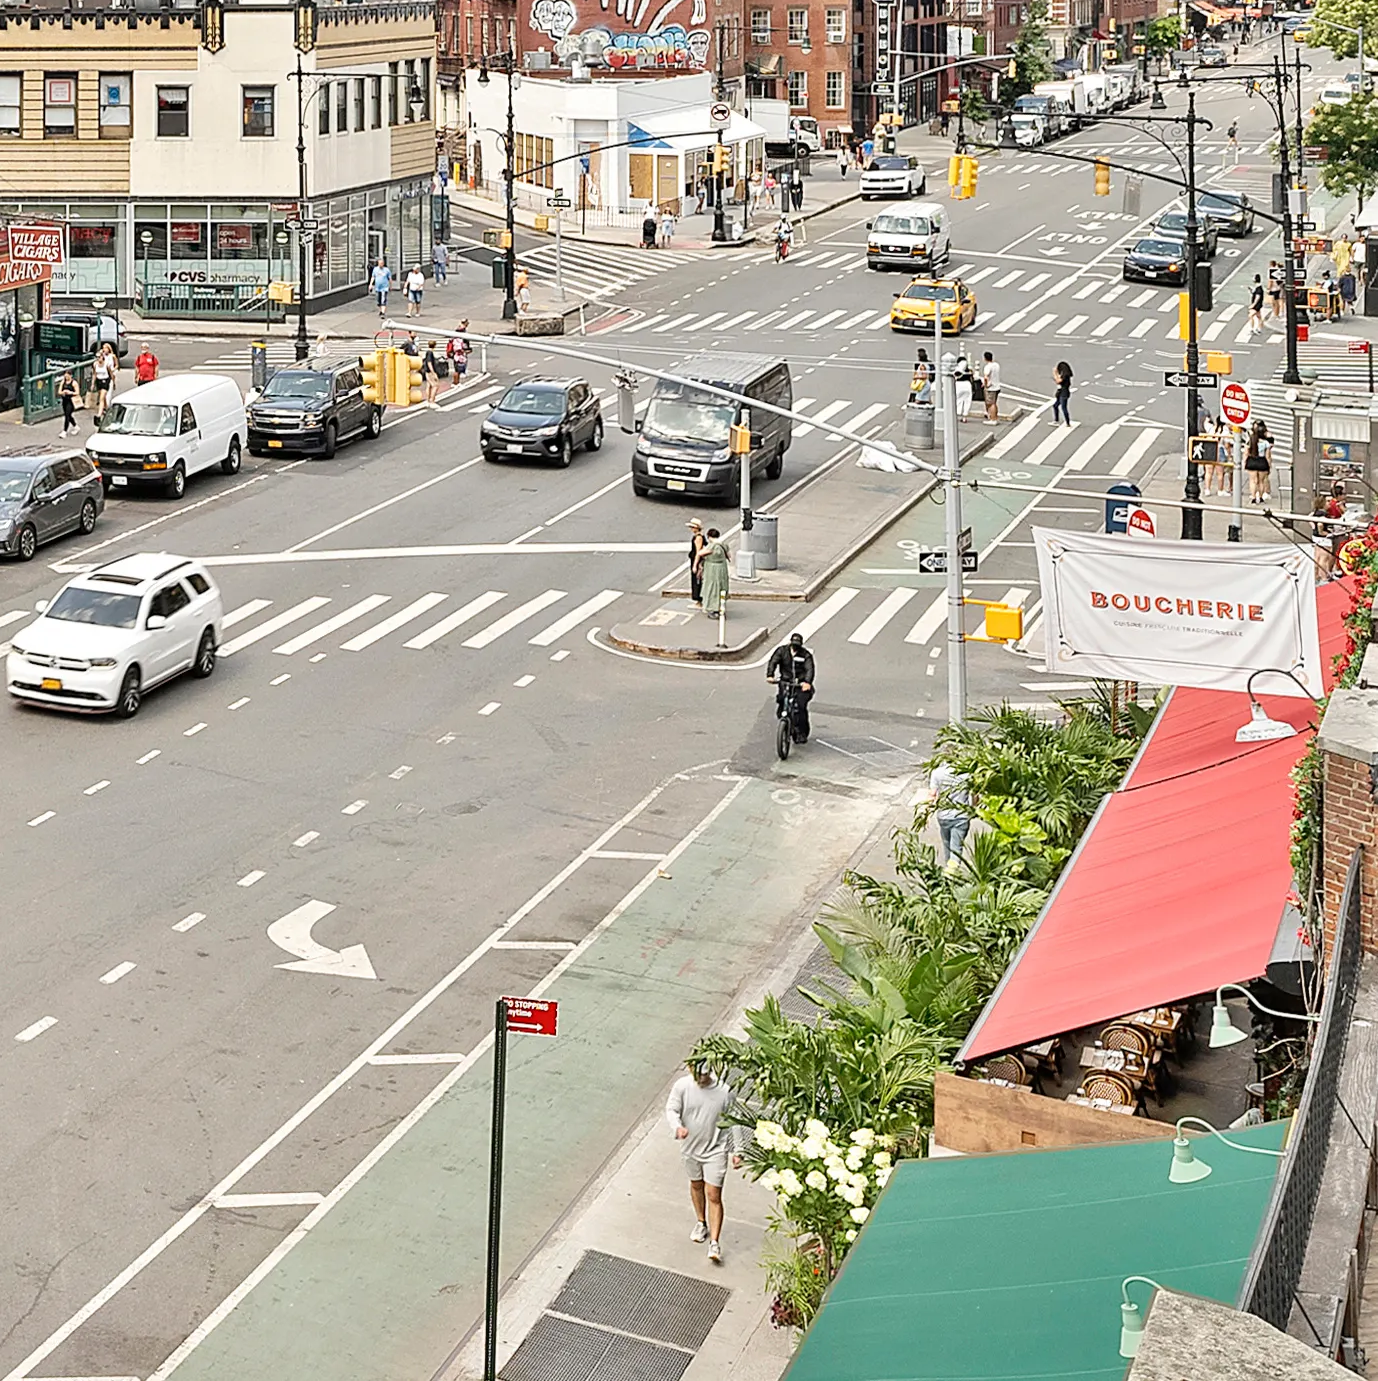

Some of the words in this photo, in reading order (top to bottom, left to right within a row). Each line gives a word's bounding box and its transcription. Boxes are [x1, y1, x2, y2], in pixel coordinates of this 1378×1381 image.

[1073, 211, 1140, 221] ONLY
[12, 233, 60, 246] VILLAGE
[1037, 232, 1109, 245] ONLY
[14, 246, 60, 261] CIGARS
[178, 271, 207, 283] CVS
[1226, 389, 1234, 397] DO
[1235, 392, 1246, 400] NOT
[1227, 408, 1244, 418] ENTER
[1131, 516, 1140, 526] DO
[1140, 519, 1151, 531] NOT
[962, 558, 975, 567] AY
[1090, 591, 1265, 622] BOUCHERIE
[515, 1001, 549, 1011] STOPPING
[507, 1009, 532, 1017] nytime
